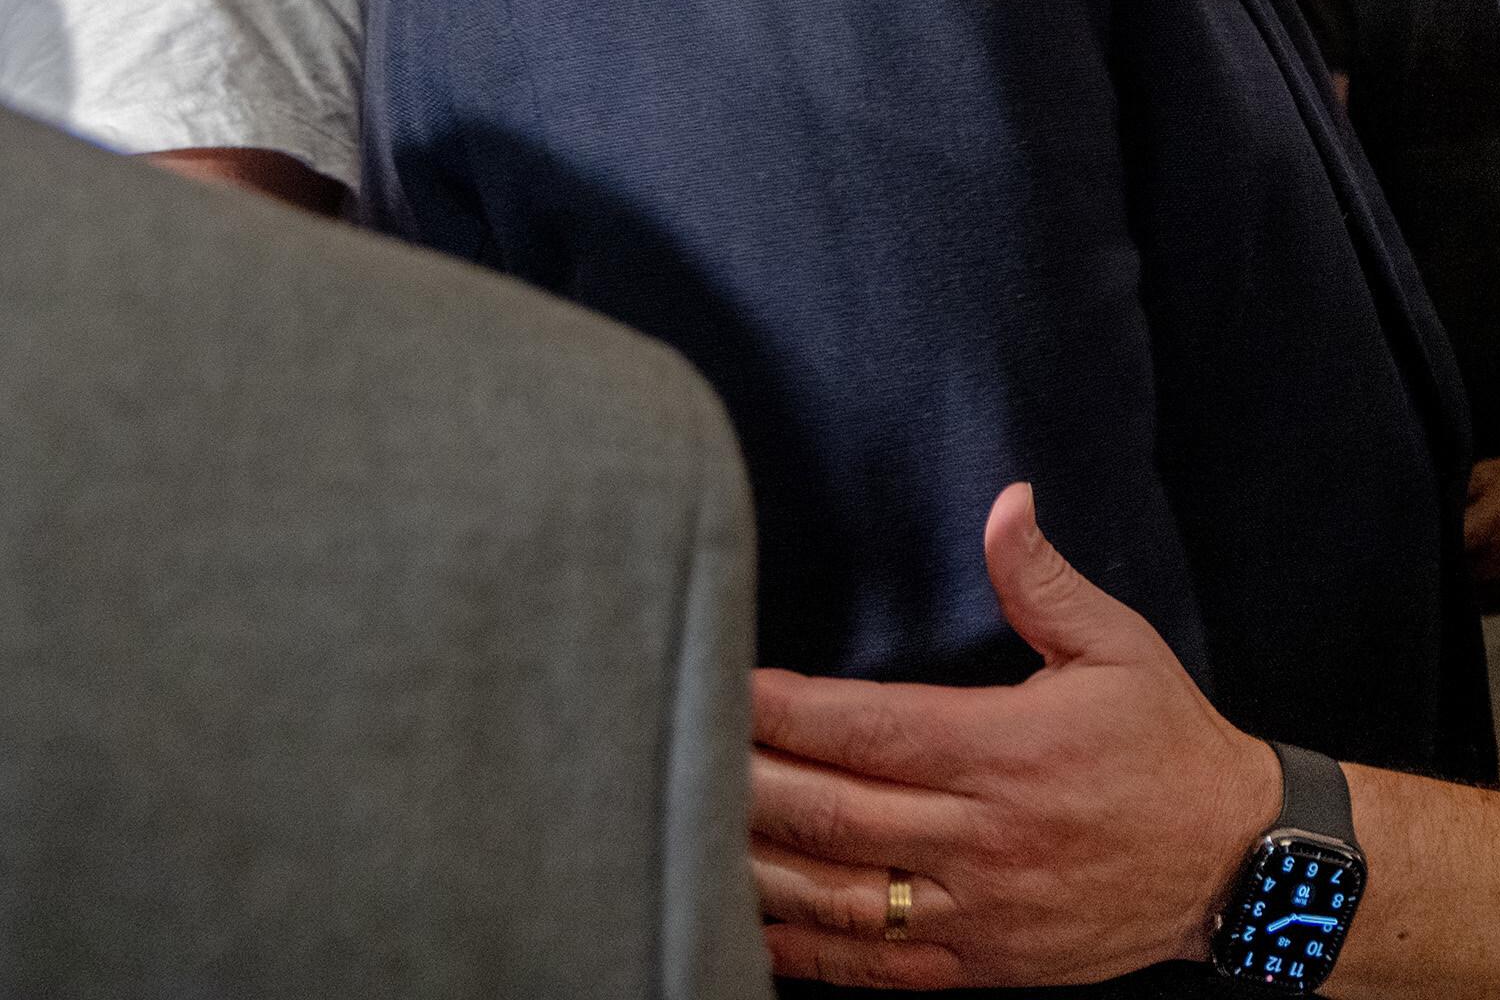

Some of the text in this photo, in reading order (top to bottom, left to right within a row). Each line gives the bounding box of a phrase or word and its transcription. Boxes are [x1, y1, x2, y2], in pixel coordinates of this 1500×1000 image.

[1282, 856, 1295, 873] 5
[1305, 862, 1319, 878] 6
[1263, 876, 1277, 893] 4
[1330, 869, 1344, 885] 7
[1252, 901, 1266, 918] 3
[1331, 892, 1345, 910] 8
[1242, 925, 1257, 943] 2
[1305, 940, 1324, 958] 10
[1244, 951, 1254, 967] 1
[1264, 955, 1283, 974] 12
[1288, 961, 1304, 978] 11
